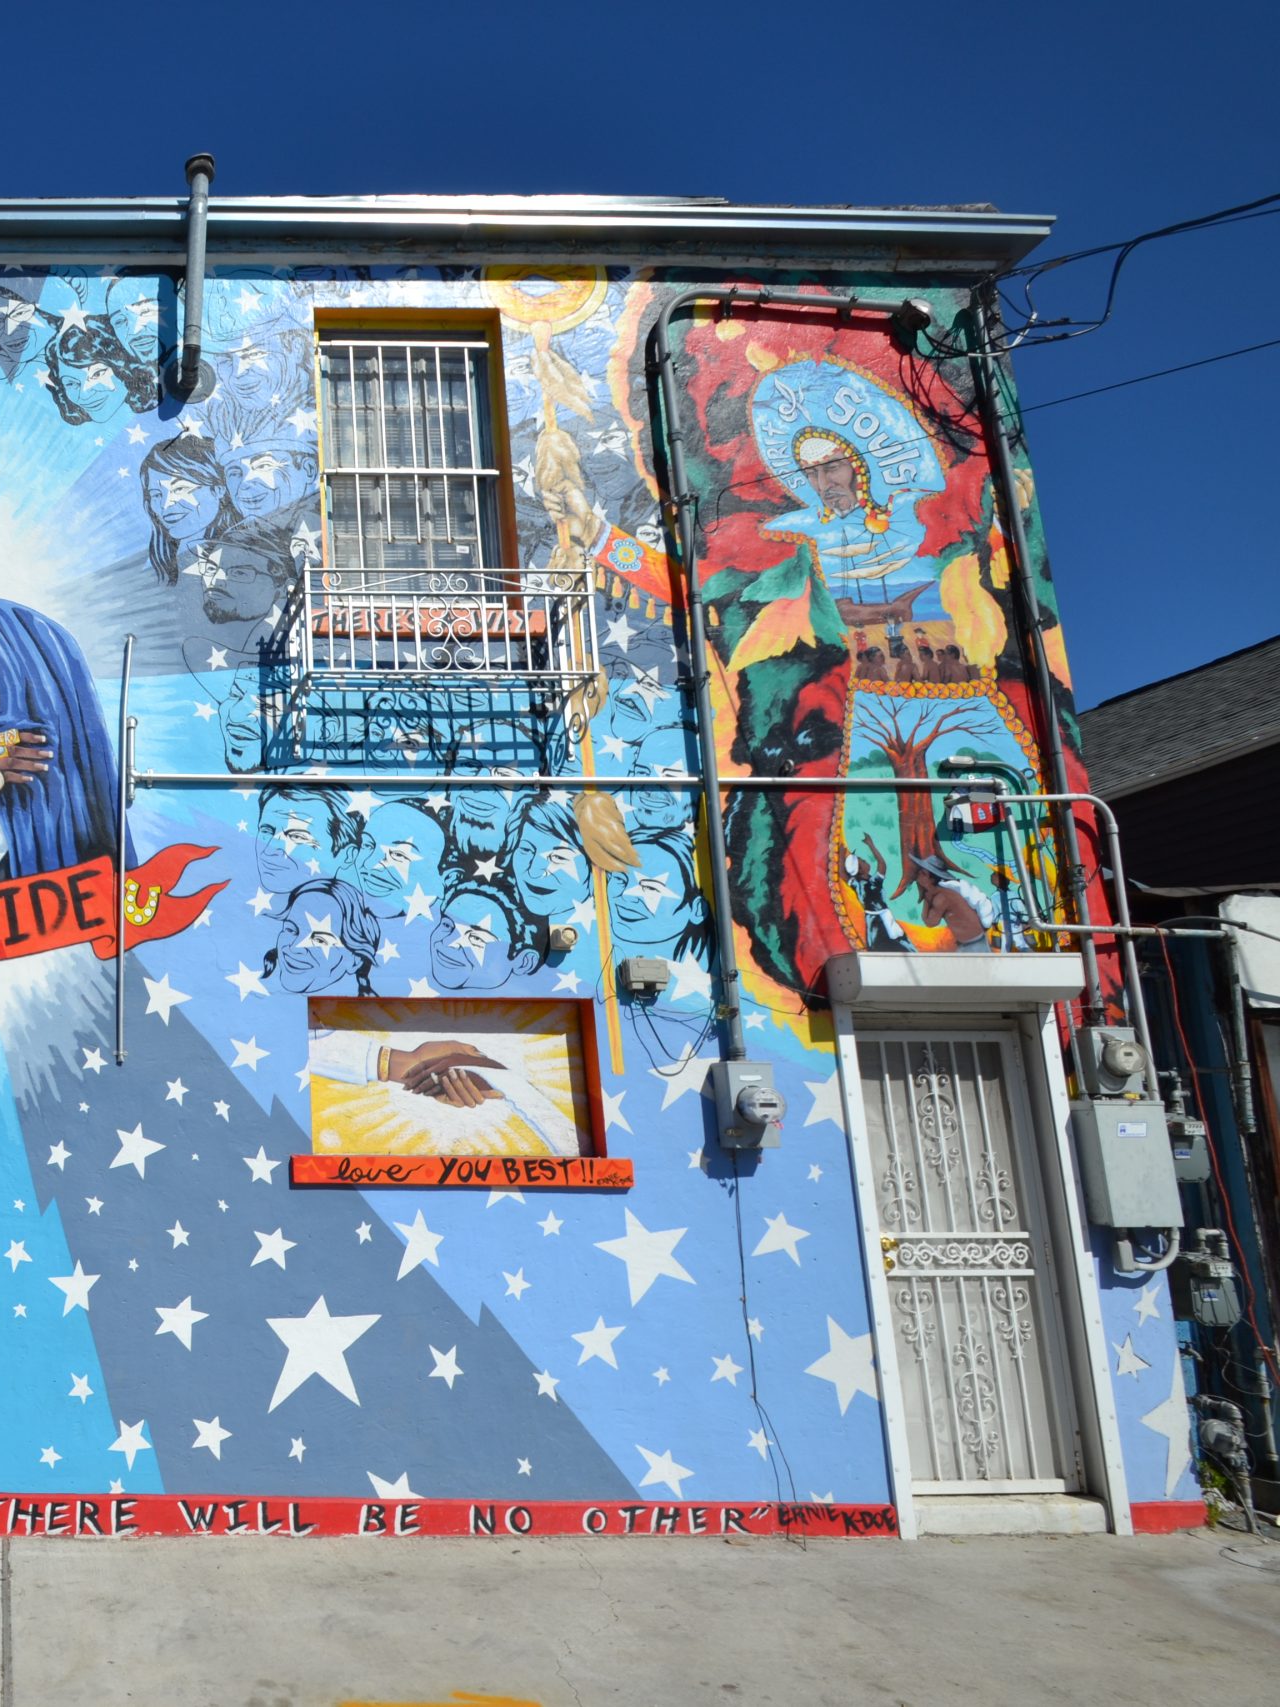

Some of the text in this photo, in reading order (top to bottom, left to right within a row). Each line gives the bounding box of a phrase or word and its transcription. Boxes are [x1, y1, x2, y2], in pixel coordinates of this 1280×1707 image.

[437, 1156, 492, 1183] YOU
[177, 1499, 319, 1537] WILL
[358, 1502, 421, 1537] BE
[469, 1503, 533, 1536] NO
[777, 1503, 841, 1527] ERNIE
